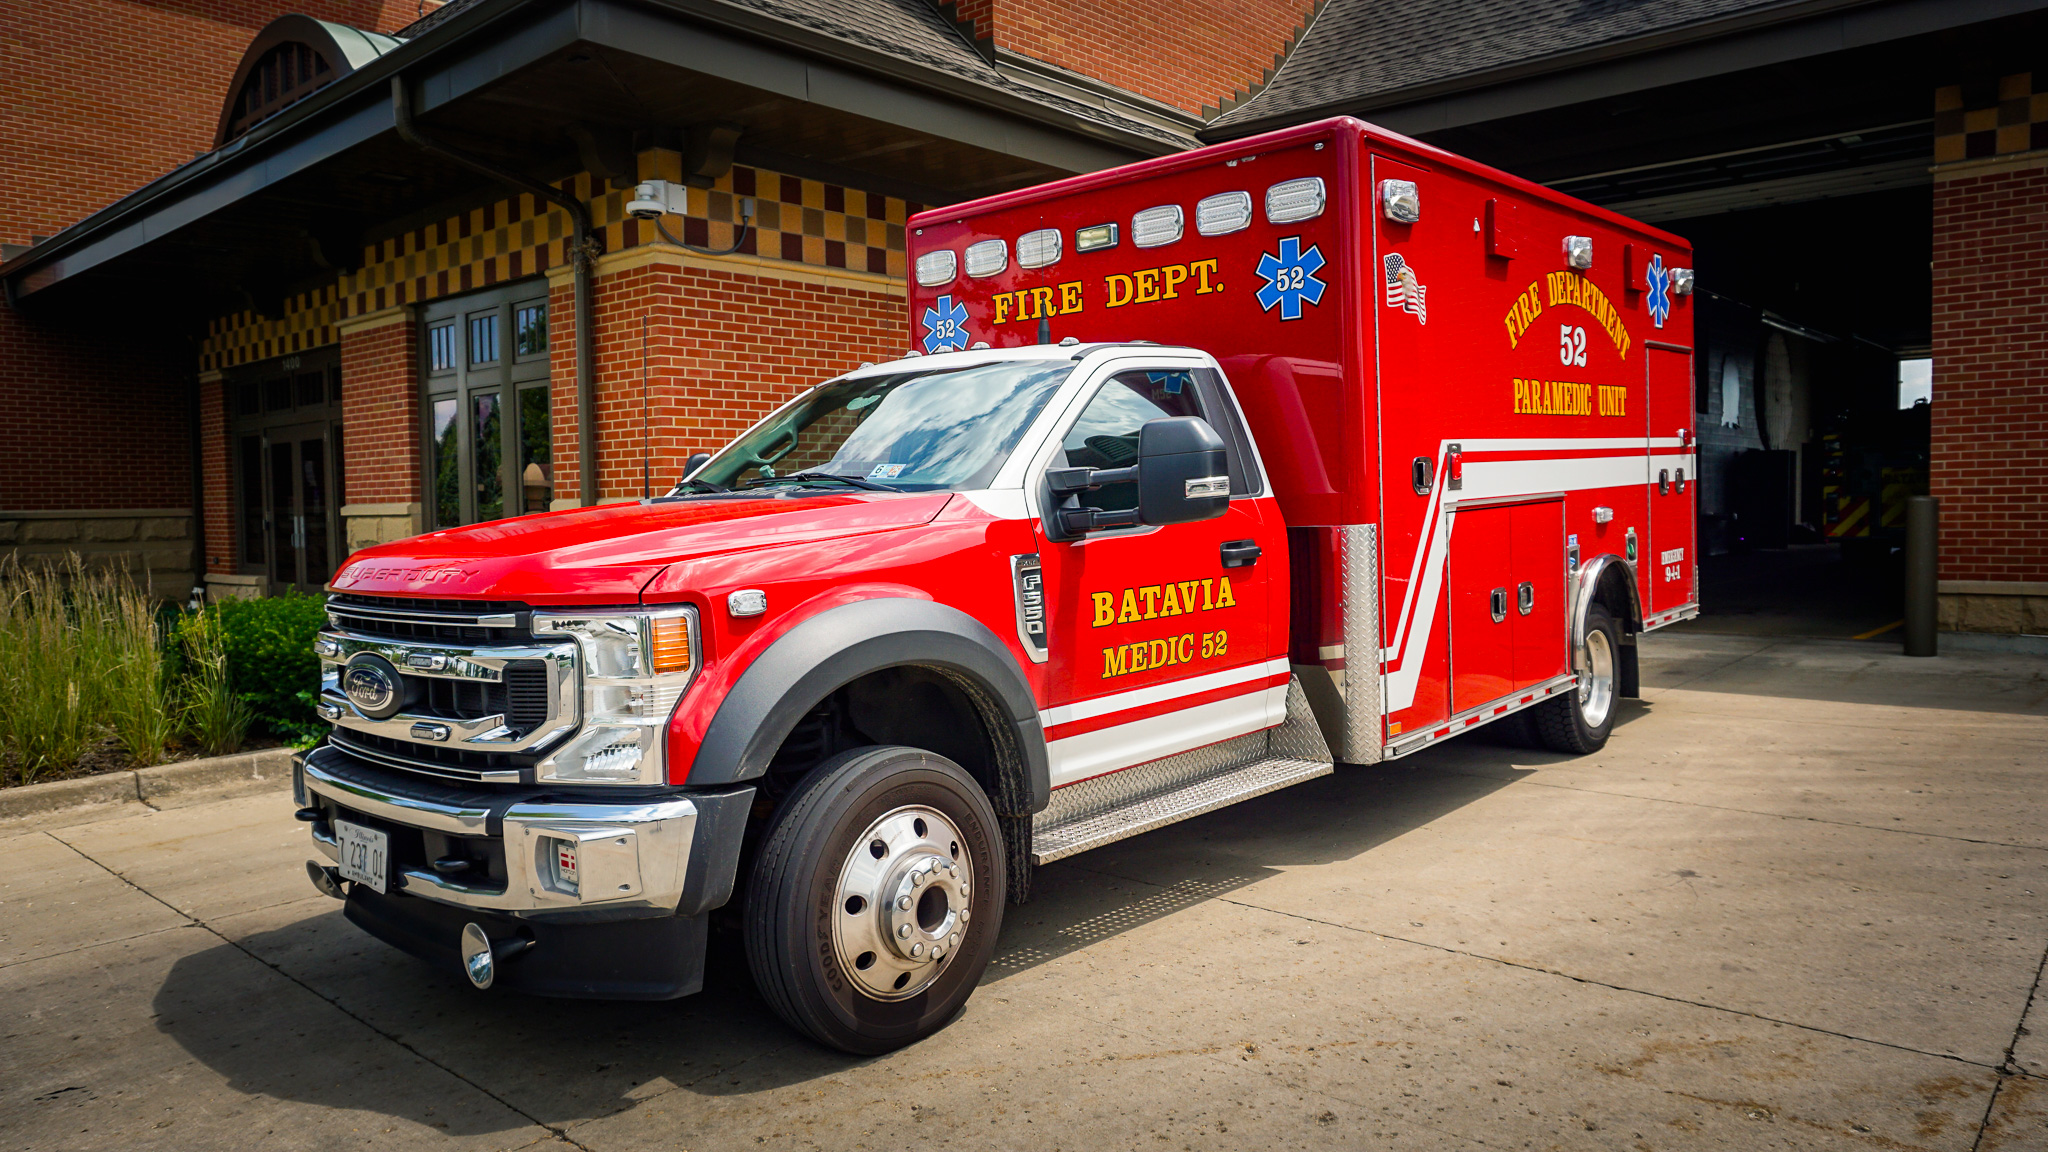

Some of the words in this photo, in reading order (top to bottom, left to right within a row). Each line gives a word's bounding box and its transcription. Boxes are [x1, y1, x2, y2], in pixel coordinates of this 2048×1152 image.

[992, 280, 1084, 325] FIRE
[1104, 257, 1225, 309] DEPT.
[1276, 265, 1305, 292] 52
[936, 318, 955, 339] 52
[1504, 279, 1543, 351] FIRE
[1546, 270, 1631, 362] DEPARTMENT
[1560, 323, 1587, 368] 52
[1513, 377, 1592, 417] PARAMEDIC
[1598, 384, 1627, 417] UNIT
[341, 566, 403, 581] SUPER
[403, 569, 480, 584] DUTY
[1661, 547, 1684, 566] EMERGENCY
[1091, 575, 1236, 628] BATAVIA
[1101, 632, 1195, 680] MEDIC
[1201, 629, 1228, 659] 52
[352, 673, 378, 701] Ford
[338, 836, 345, 865] 7
[350, 841, 367, 873] 237
[372, 849, 384, 880] 01
